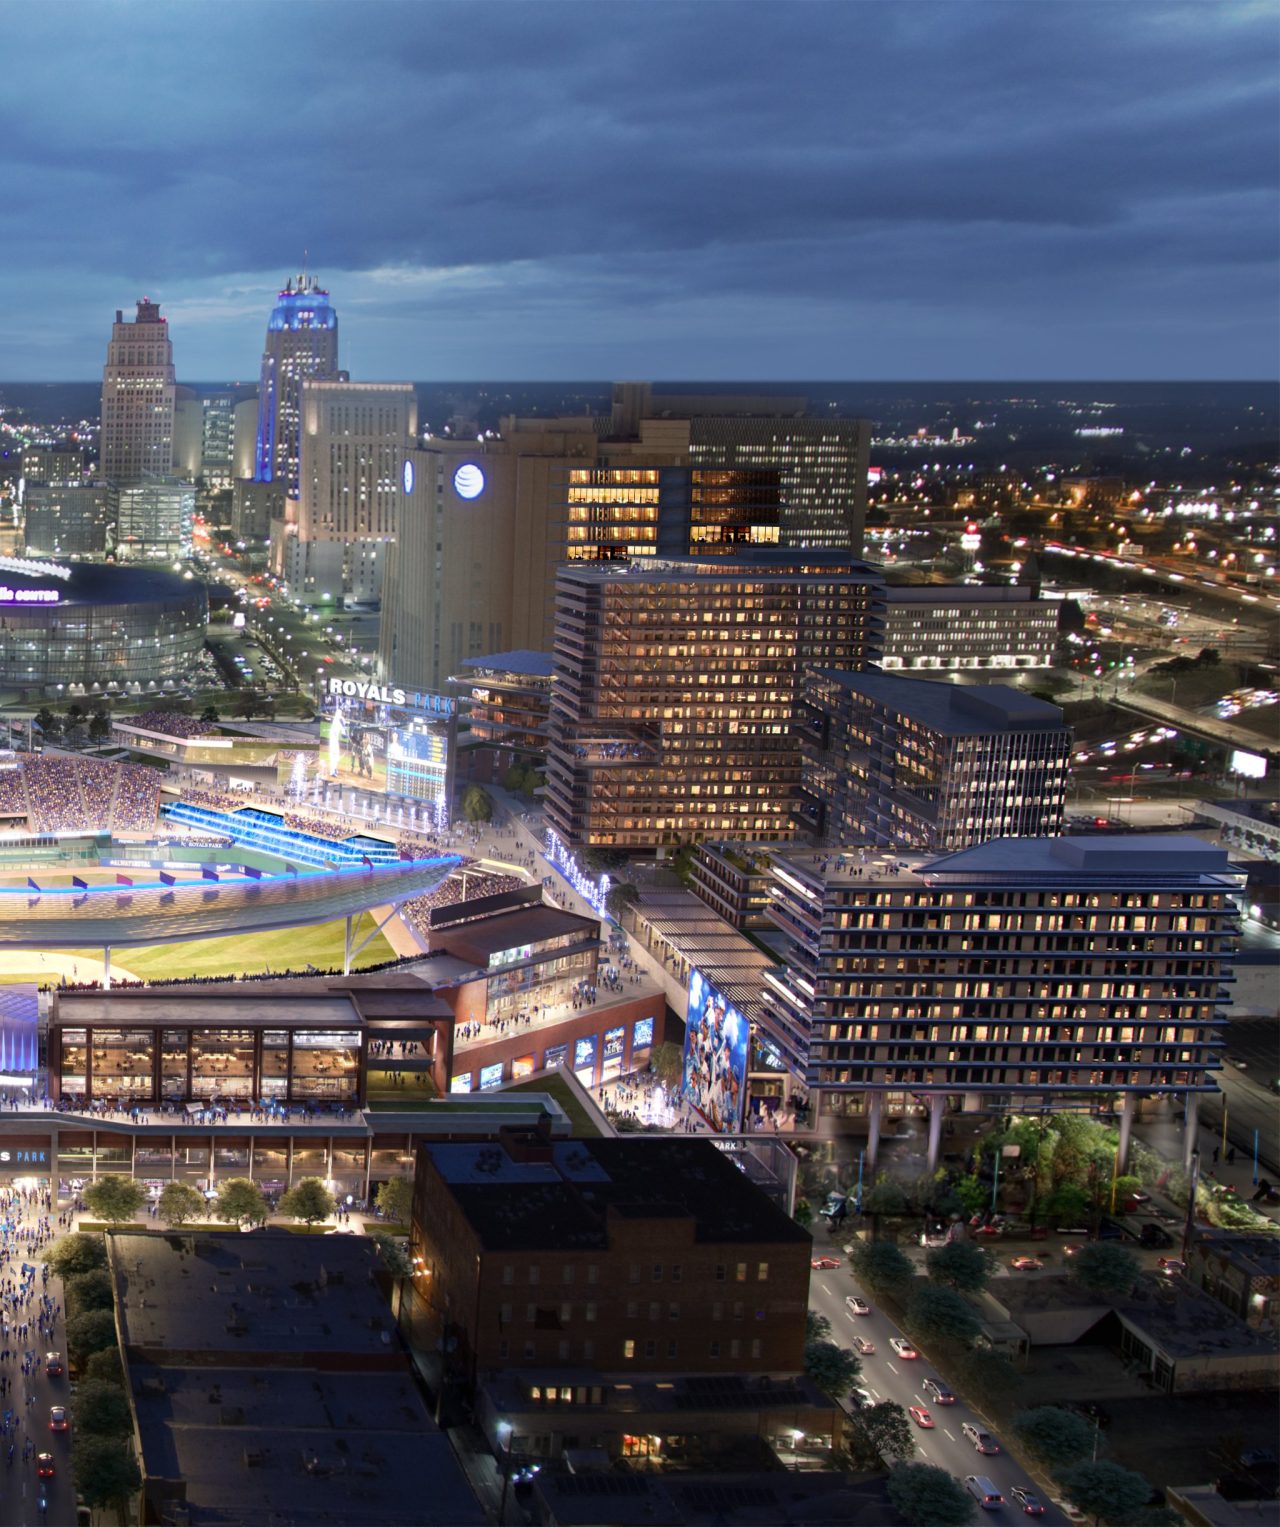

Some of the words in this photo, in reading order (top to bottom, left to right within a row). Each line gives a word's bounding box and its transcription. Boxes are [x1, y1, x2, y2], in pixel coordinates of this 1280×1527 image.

[330, 678, 406, 705] ROYALS
[414, 692, 453, 714] PARK
[17, 1151, 46, 1162] PARK
